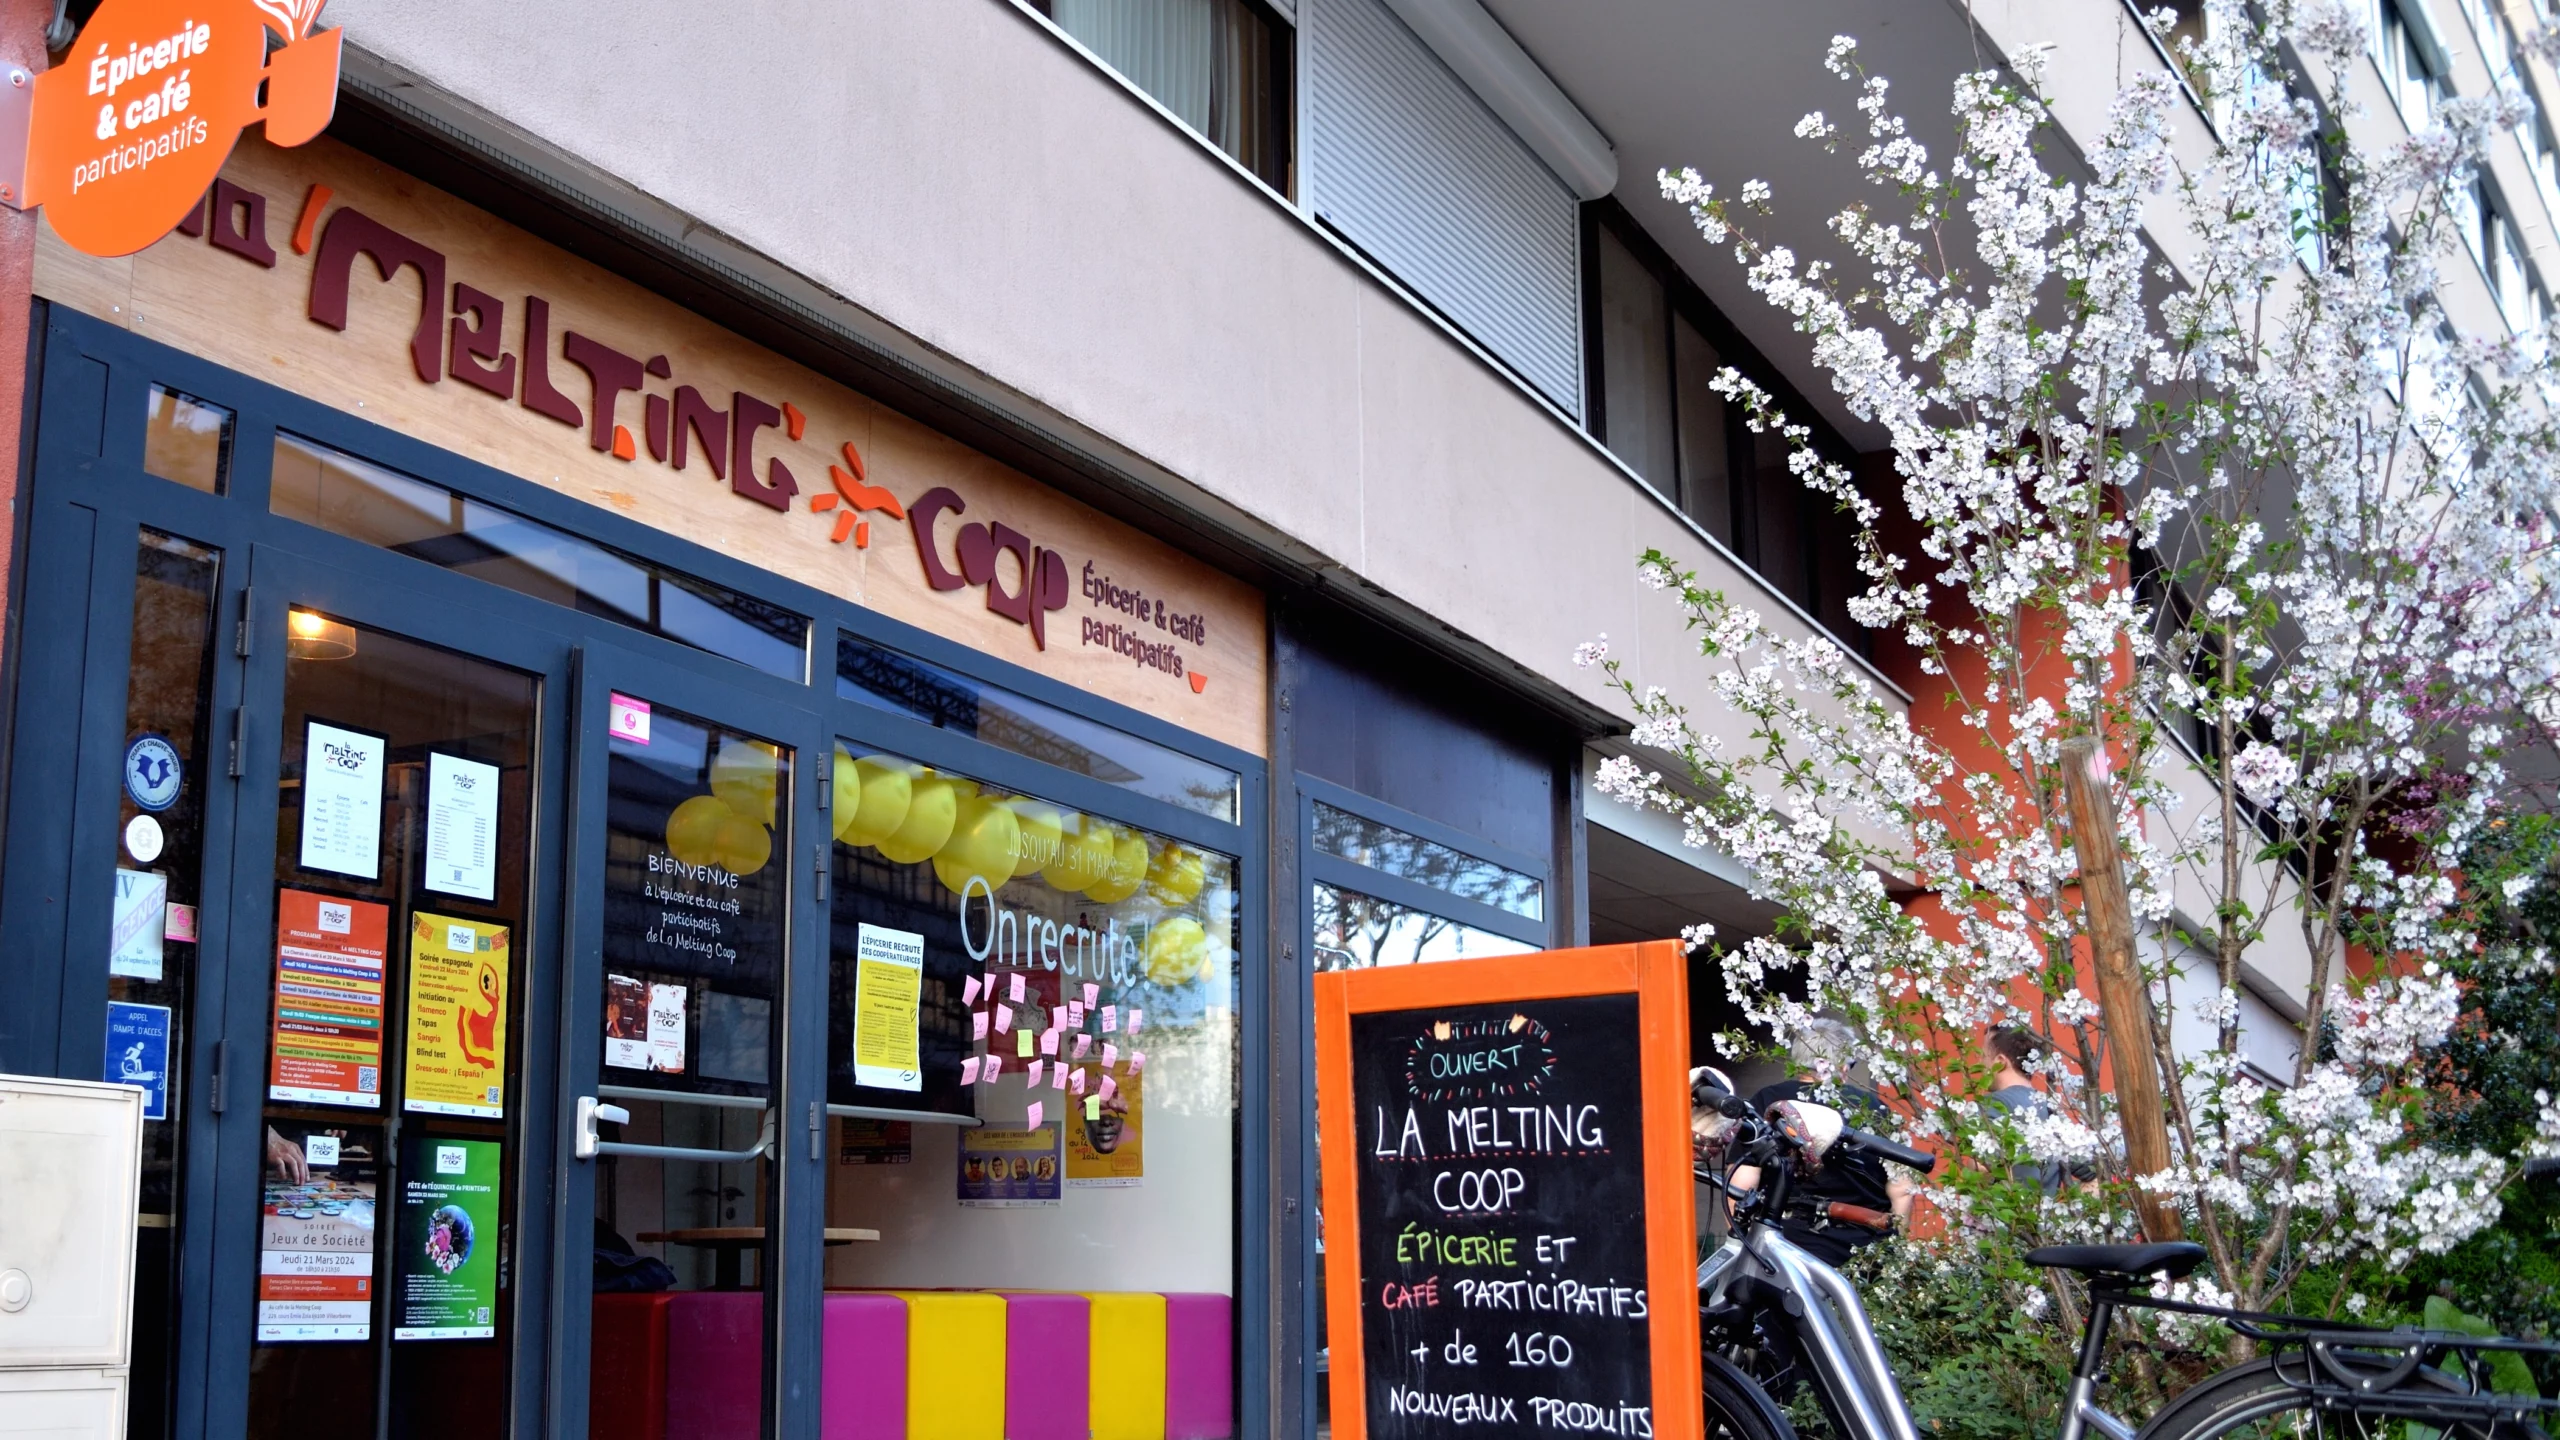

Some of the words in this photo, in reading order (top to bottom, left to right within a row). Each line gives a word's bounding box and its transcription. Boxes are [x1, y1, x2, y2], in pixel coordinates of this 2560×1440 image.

[88, 20, 211, 97] Épicerie
[96, 104, 118, 140] &
[125, 69, 191, 130] café
[73, 116, 207, 195] participatifs
[1083, 560, 1150, 622] Épicerie
[1154, 600, 1167, 630] &
[1170, 613, 1205, 646] café
[1082, 616, 1183, 678] participatifs
[130, 741, 146, 761] CHARTE
[648, 851, 739, 889] BIENVENUE
[1069, 844, 1082, 872] 31
[1088, 852, 1118, 882] MARS
[113, 882, 166, 948] ICENCE
[644, 881, 653, 897] à
[654, 883, 694, 905] l'épicerie
[695, 893, 705, 908] et
[706, 898, 719, 910] au
[720, 898, 740, 917] café
[661, 911, 721, 937] participatifs
[960, 875, 1017, 966] On
[419, 952, 440, 963] Soirée
[442, 957, 473, 969] espagnole
[646, 926, 659, 943] de
[660, 928, 673, 947] La
[675, 932, 713, 959] Melting
[715, 942, 736, 965] Coop
[861, 947, 872, 956] DES
[862, 934, 893, 950] L'ÉPICERIE
[893, 941, 921, 955] RECRUTE
[417, 1004, 447, 1016] flamenco
[418, 991, 447, 1002] Initiation
[113, 1024, 135, 1035] RAMPE
[128, 1012, 148, 1022] APPEL
[417, 1018, 437, 1028] Tapas
[416, 1048, 433, 1057] Blind
[434, 1049, 446, 1059] test
[417, 1032, 441, 1044] Sangria
[415, 1064, 448, 1074] Dress-code
[457, 1068, 480, 1078] España
[1430, 1044, 1523, 1079] OUVERT
[1376, 1105, 1426, 1157] LA
[1448, 1103, 1604, 1153] MELTING
[462, 1184, 491, 1192] PRINTEMPS
[1434, 1168, 1525, 1212] COOP
[271, 1233, 298, 1245] Jeux
[303, 1234, 317, 1245] de
[322, 1234, 366, 1246] Société
[304, 1223, 336, 1231] SOIRÉE
[1396, 1221, 1518, 1266] ÉPICERIE
[1535, 1235, 1577, 1263] ET
[281, 1254, 302, 1264] Jeudi
[303, 1255, 314, 1264] 21
[315, 1255, 334, 1265] Mars
[335, 1256, 355, 1265] 2024
[1382, 1275, 1440, 1310] CAFÉ
[1454, 1270, 1648, 1318] PARTICIPATIFS
[1444, 1328, 1478, 1364] de
[1505, 1331, 1572, 1368] 160
[1390, 1384, 1518, 1425] NOUVEAUX
[1528, 1396, 1653, 1440] PRODUITS
